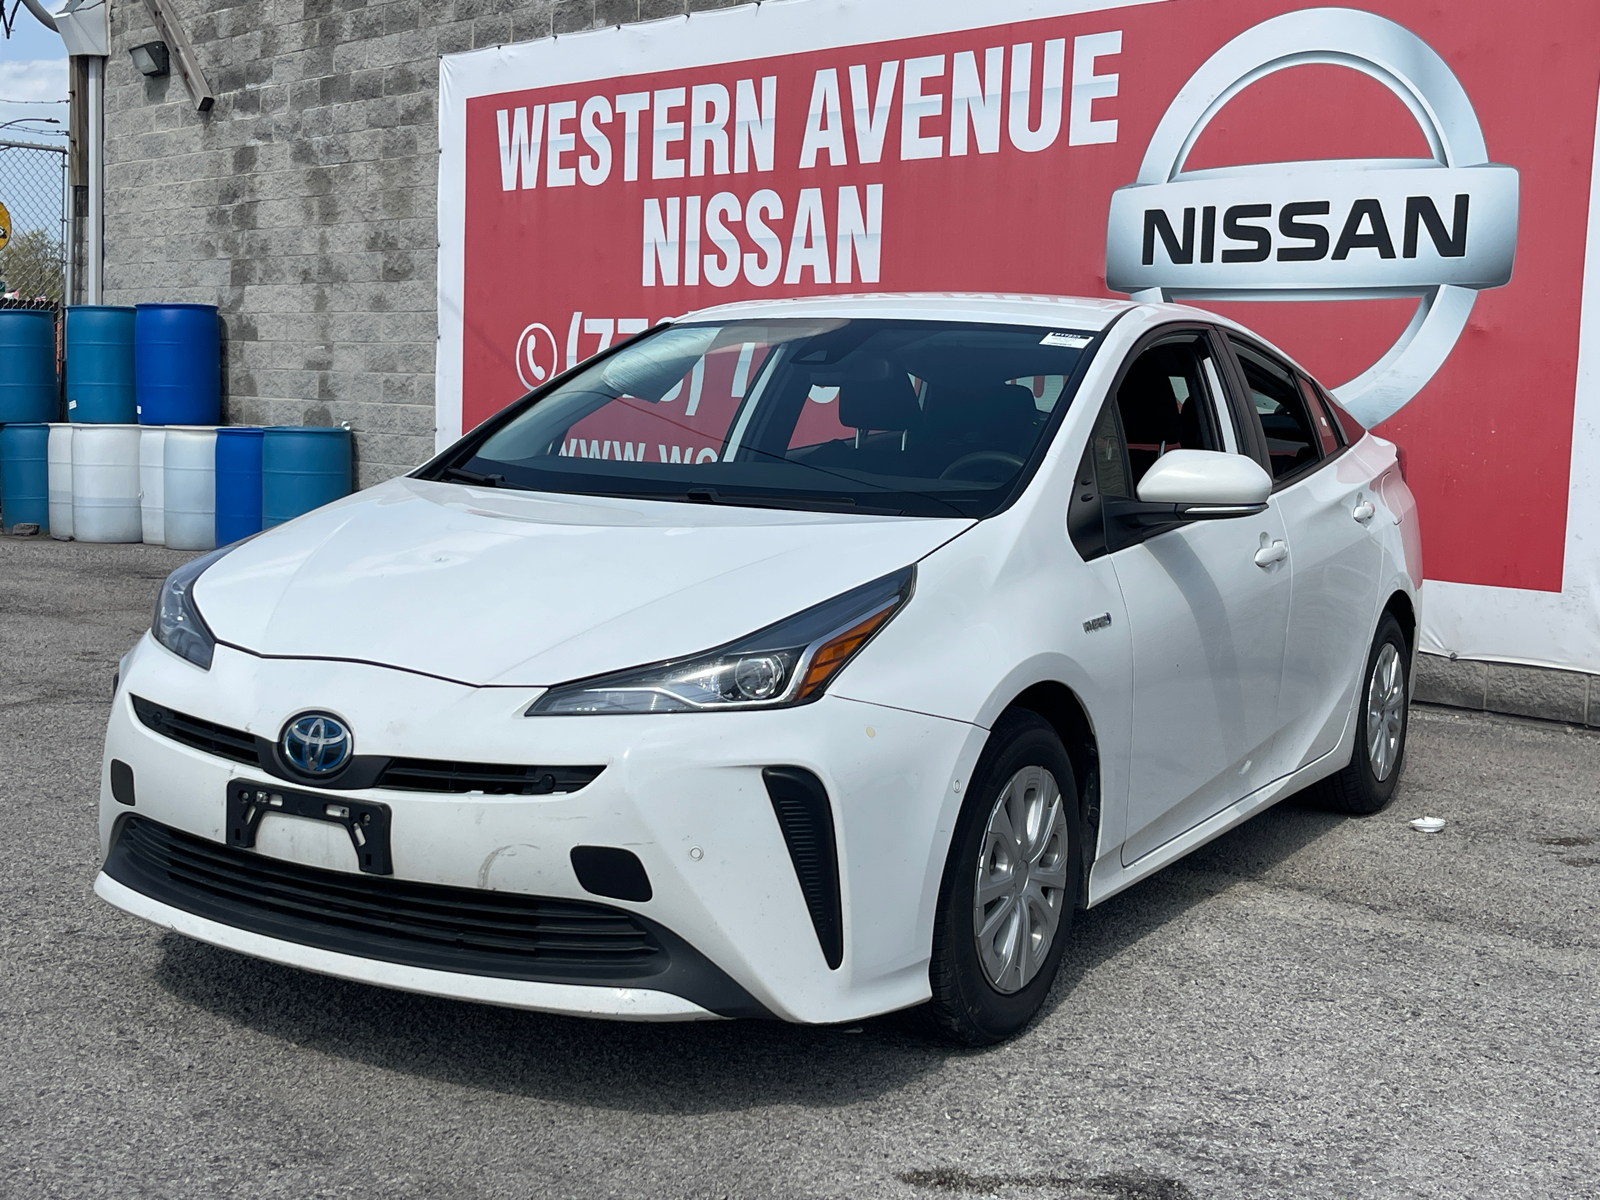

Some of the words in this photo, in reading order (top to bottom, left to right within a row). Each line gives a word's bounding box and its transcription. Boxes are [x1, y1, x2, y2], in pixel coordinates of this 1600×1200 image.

[497, 75, 777, 191] WESTERN
[799, 30, 1122, 169] AVENUE
[642, 184, 884, 287] NISSAN
[1142, 194, 1470, 266] NISSAN
